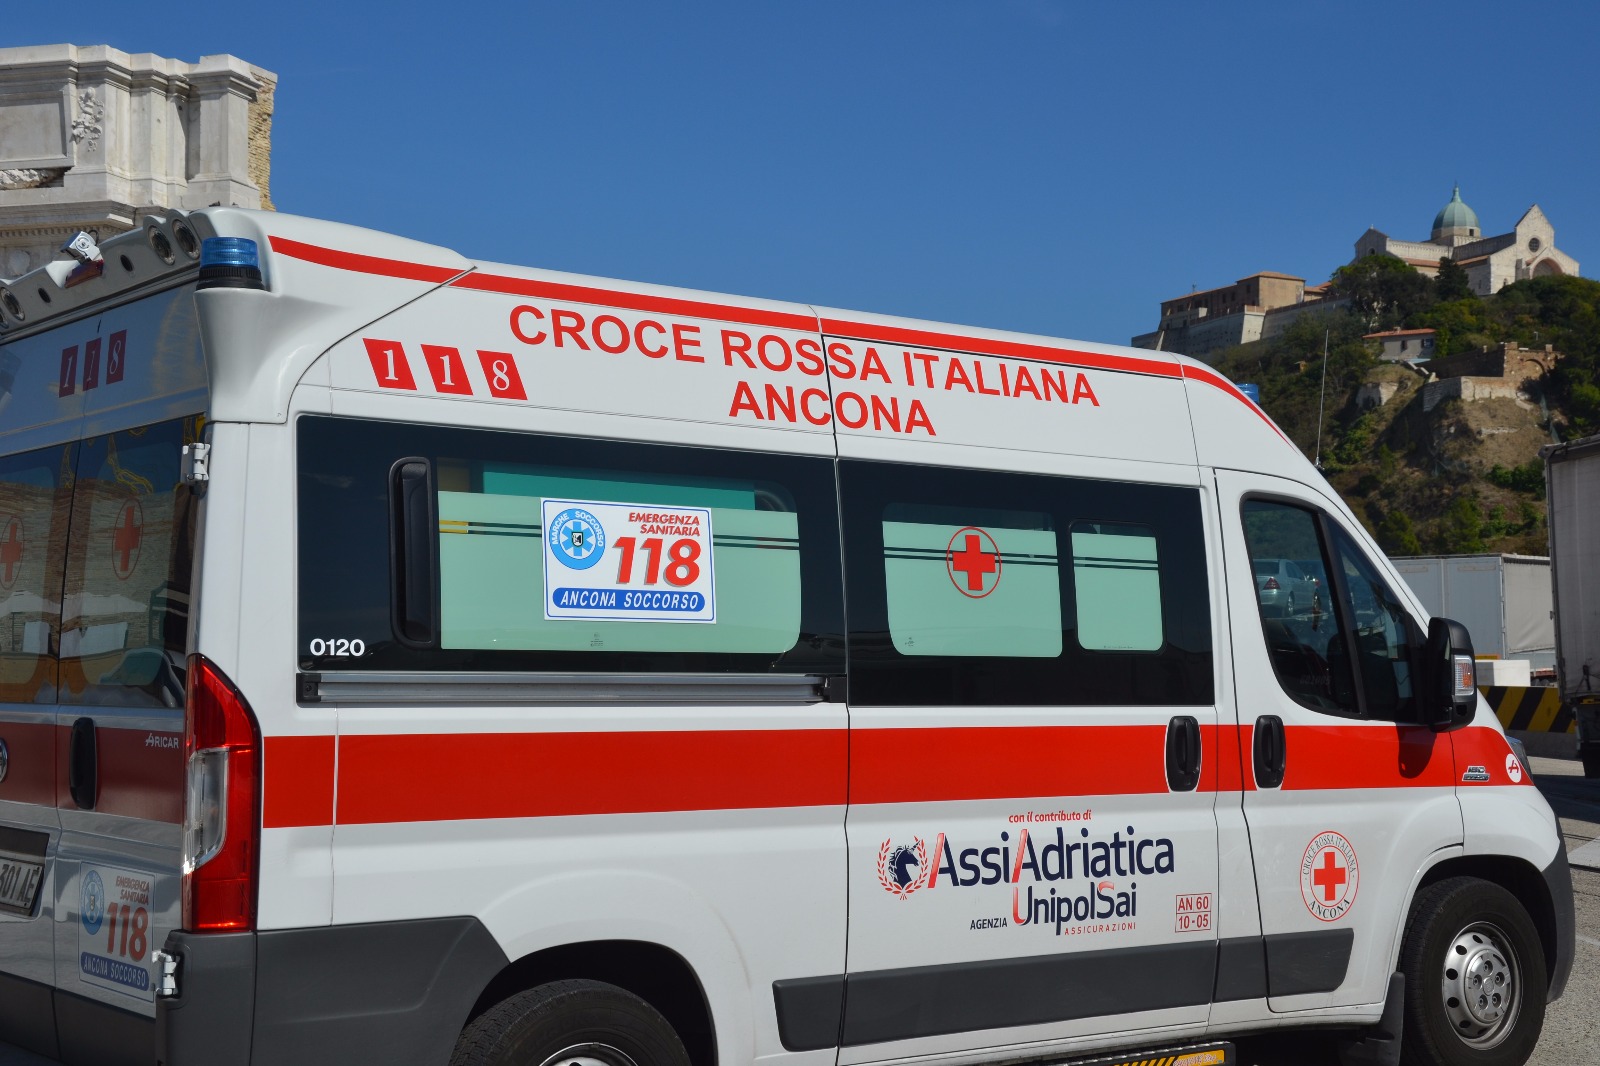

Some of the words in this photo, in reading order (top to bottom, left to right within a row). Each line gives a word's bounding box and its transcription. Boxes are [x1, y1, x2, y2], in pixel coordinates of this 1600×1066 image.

[509, 304, 705, 363] CROCE
[720, 329, 892, 383] ROSSA
[903, 351, 1100, 407] ITALIANA
[383, 349, 510, 391] 118
[729, 380, 937, 436] ANCONA
[551, 512, 570, 545] MARCHE
[574, 510, 604, 548] SOCCORSO
[628, 512, 701, 526] EMERGENZA
[640, 523, 701, 537] SANITARIA
[612, 536, 702, 588] 118
[560, 590, 617, 607] ANCONA
[623, 593, 699, 610] SOCCORSO
[309, 637, 366, 657] 0120
[145, 732, 179, 749] ARICAR
[1008, 813, 1025, 823] con
[1026, 811, 1033, 823] il
[1034, 809, 1082, 822] contributo
[1083, 809, 1092, 821] di
[927, 825, 1175, 888] AssiAdriatica
[1302, 845, 1317, 876] CROCE
[1314, 834, 1335, 850] ROSSA
[1334, 836, 1357, 873] ITALIANA
[116, 875, 150, 893] EMERGENZA
[120, 889, 149, 905] SANITARIA
[1177, 897, 1194, 911] AN
[1196, 896, 1209, 909] 60
[1012, 881, 1137, 936] UnipolSai
[1309, 899, 1351, 919] ANCONA
[969, 917, 1008, 930] AGENZIA
[1064, 922, 1136, 936] ASSICURAZIONI
[1178, 914, 1209, 929] 10-05
[107, 902, 149, 963] 118
[83, 956, 108, 976] ANCONA
[110, 962, 146, 987] SOCCORSO
